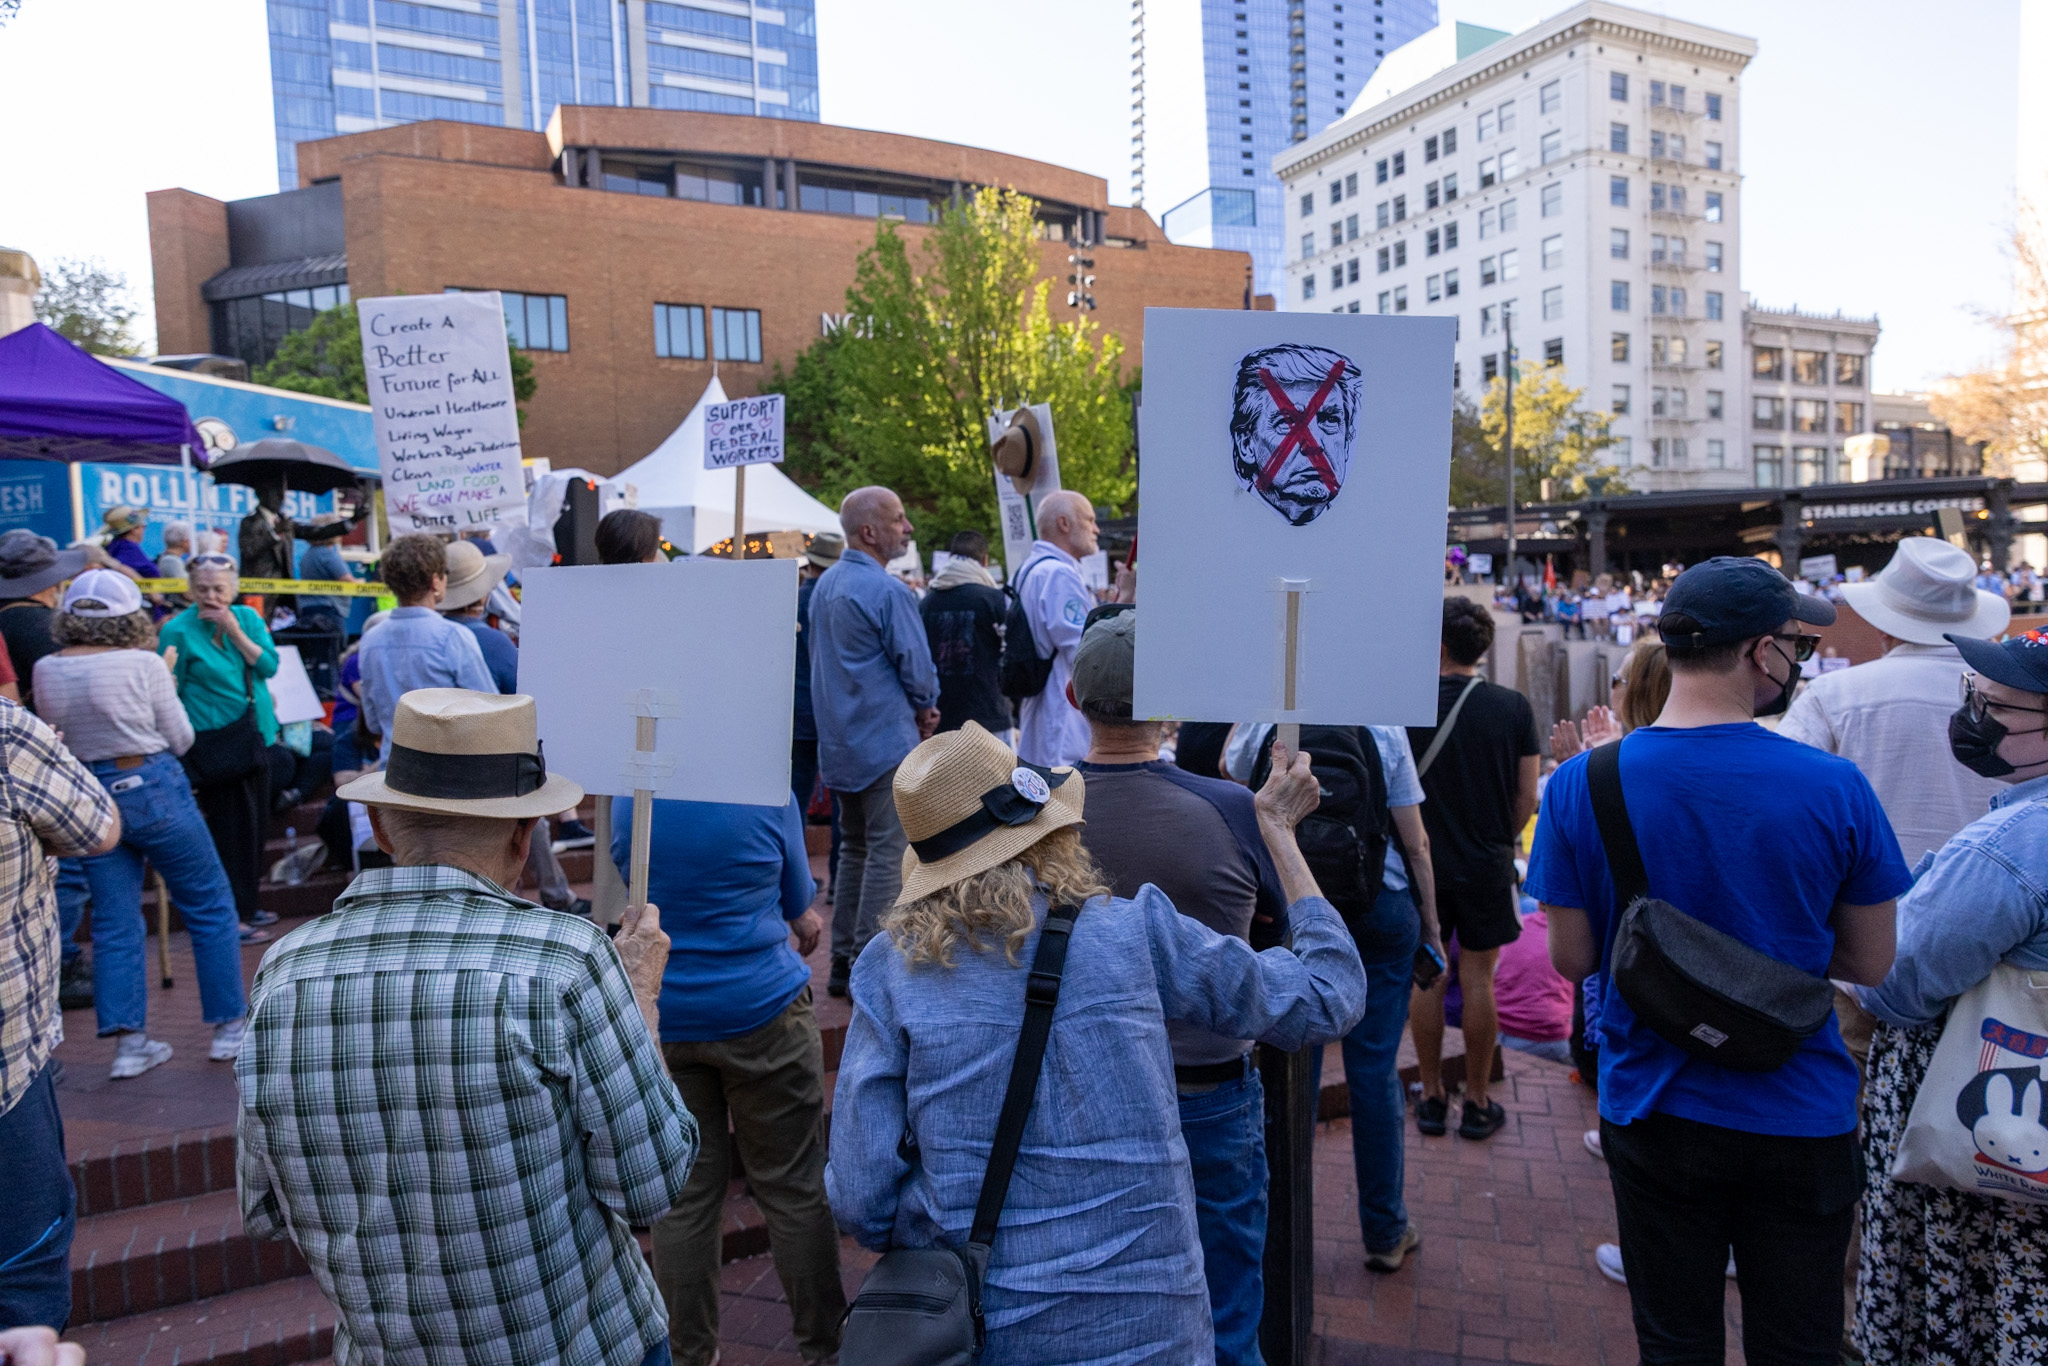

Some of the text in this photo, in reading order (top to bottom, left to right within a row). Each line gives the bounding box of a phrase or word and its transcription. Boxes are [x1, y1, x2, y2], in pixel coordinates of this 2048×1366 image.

[371, 313, 455, 337] Create A
[371, 344, 451, 369] Better
[447, 372, 468, 393] for
[471, 368, 501, 385] ALL
[707, 397, 780, 422] SUPPORT
[388, 424, 473, 444] Living Wages
[710, 429, 779, 452] FEDERAL
[712, 446, 780, 465] WORKERS
[391, 468, 432, 482] Clean
[467, 462, 503, 475] WATER
[416, 475, 500, 493] LAND FOOD
[392, 485, 508, 514] WE CAN MAKE A
[467, 507, 501, 525] LIFE
[1801, 502, 1911, 520] STARBUCKS
[307, 582, 344, 593] CAUTION
